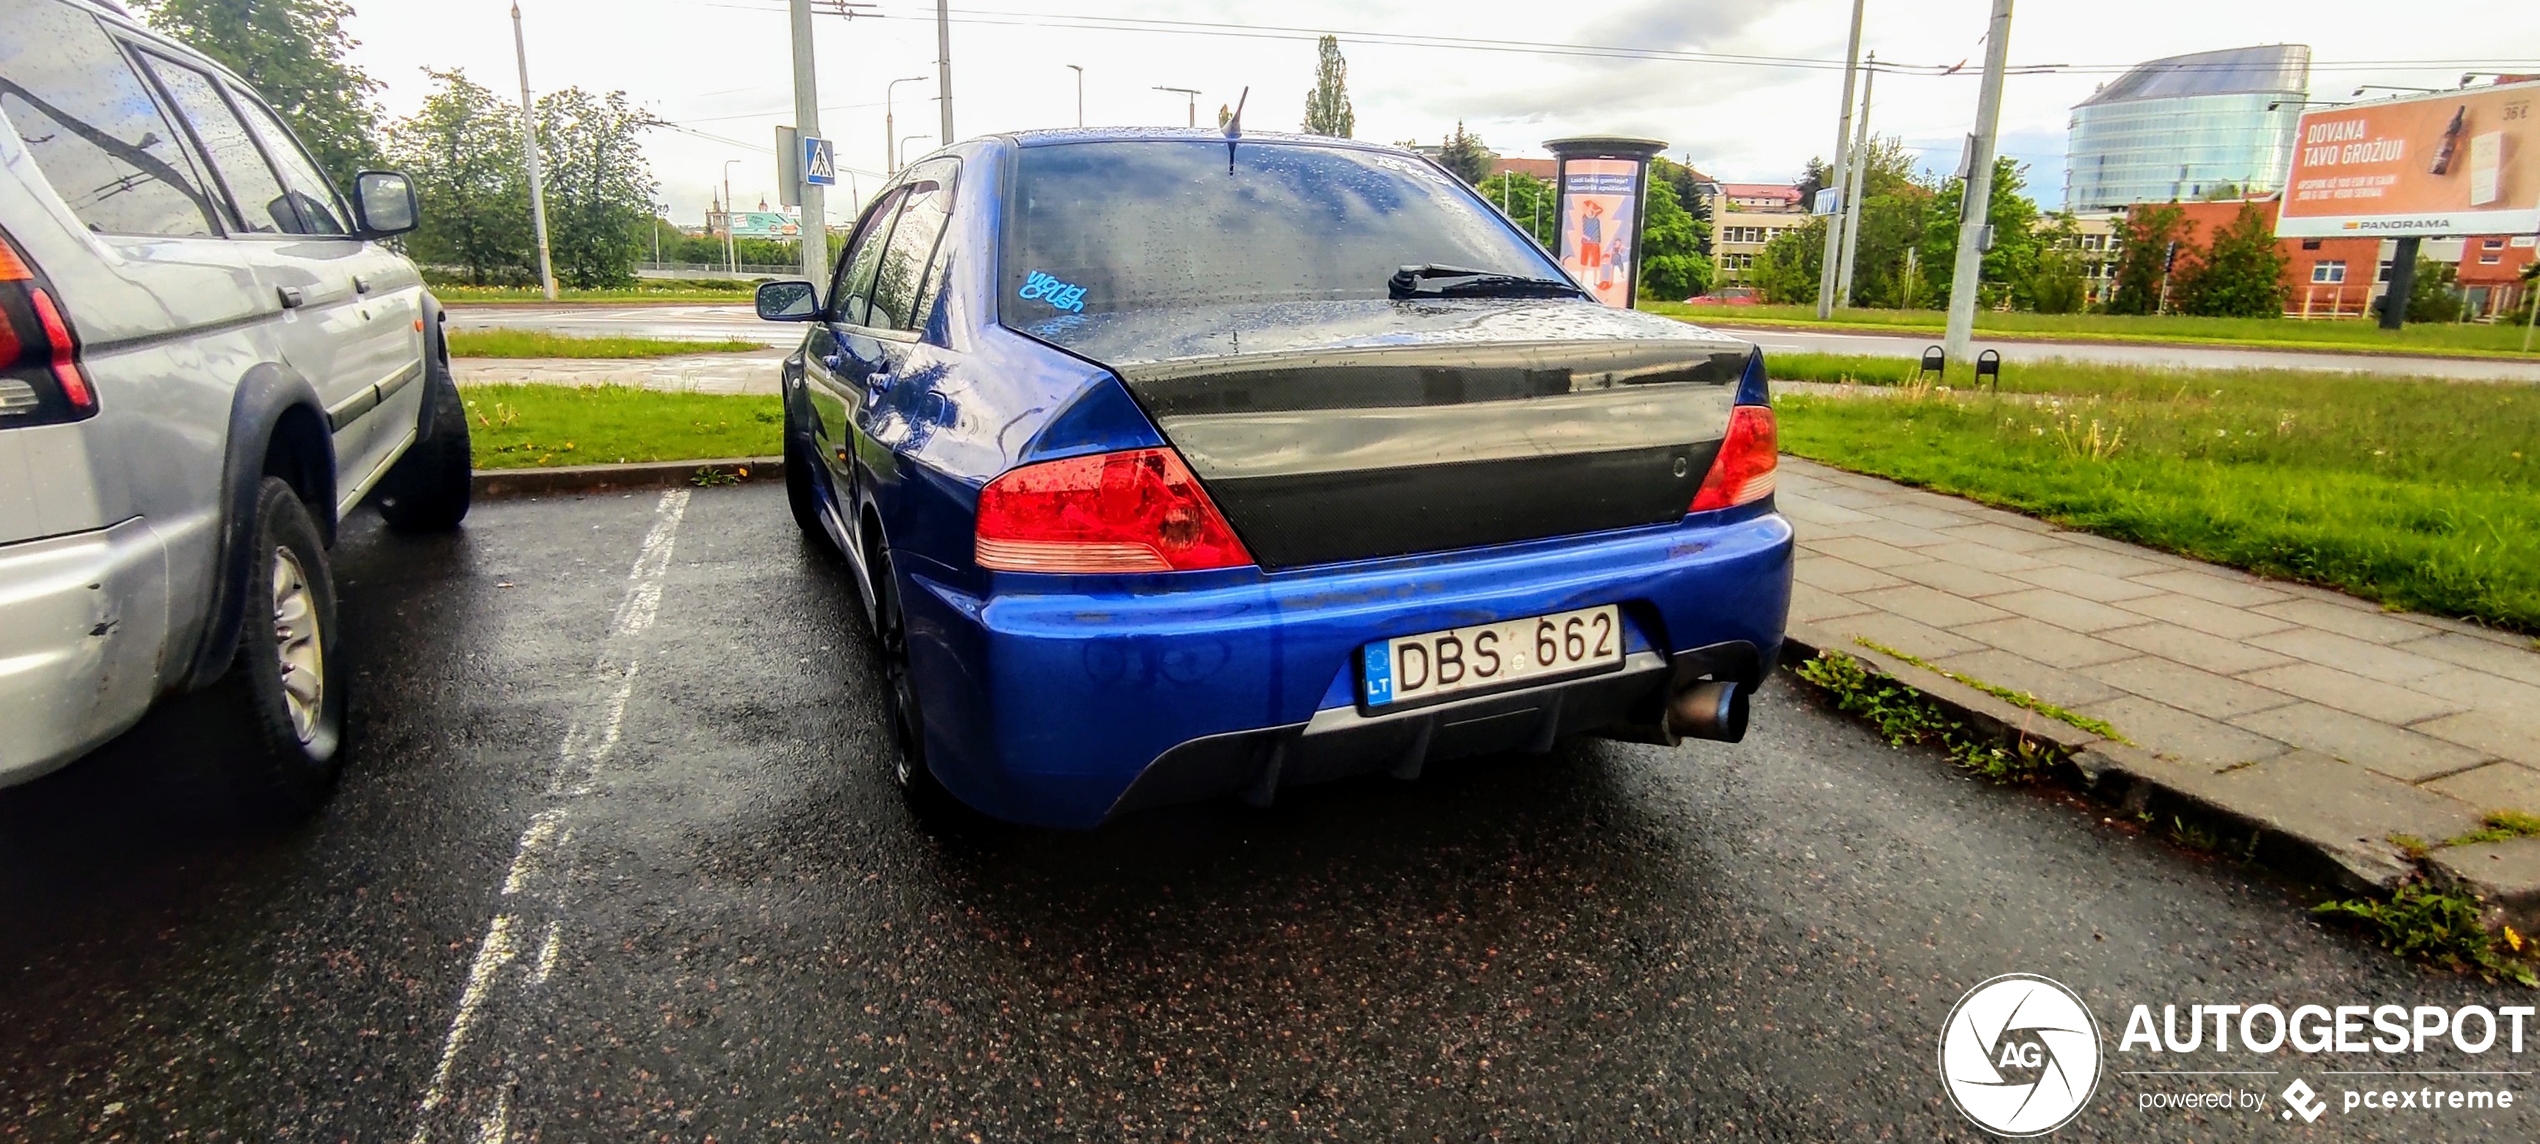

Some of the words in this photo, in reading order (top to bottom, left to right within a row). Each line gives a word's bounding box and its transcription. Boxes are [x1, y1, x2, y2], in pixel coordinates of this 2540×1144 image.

[2306, 119, 2365, 144] DOVANA
[2303, 145, 2338, 167] TAVO
[2341, 137, 2405, 165] GROŽIUI
[2360, 219, 2451, 230] PANORAMA
[1019, 284, 1084, 313] Crush
[1027, 270, 1088, 301] World
[1397, 629, 1501, 692] DBS
[1534, 611, 1613, 667] 662
[1368, 677, 1390, 695] LT
